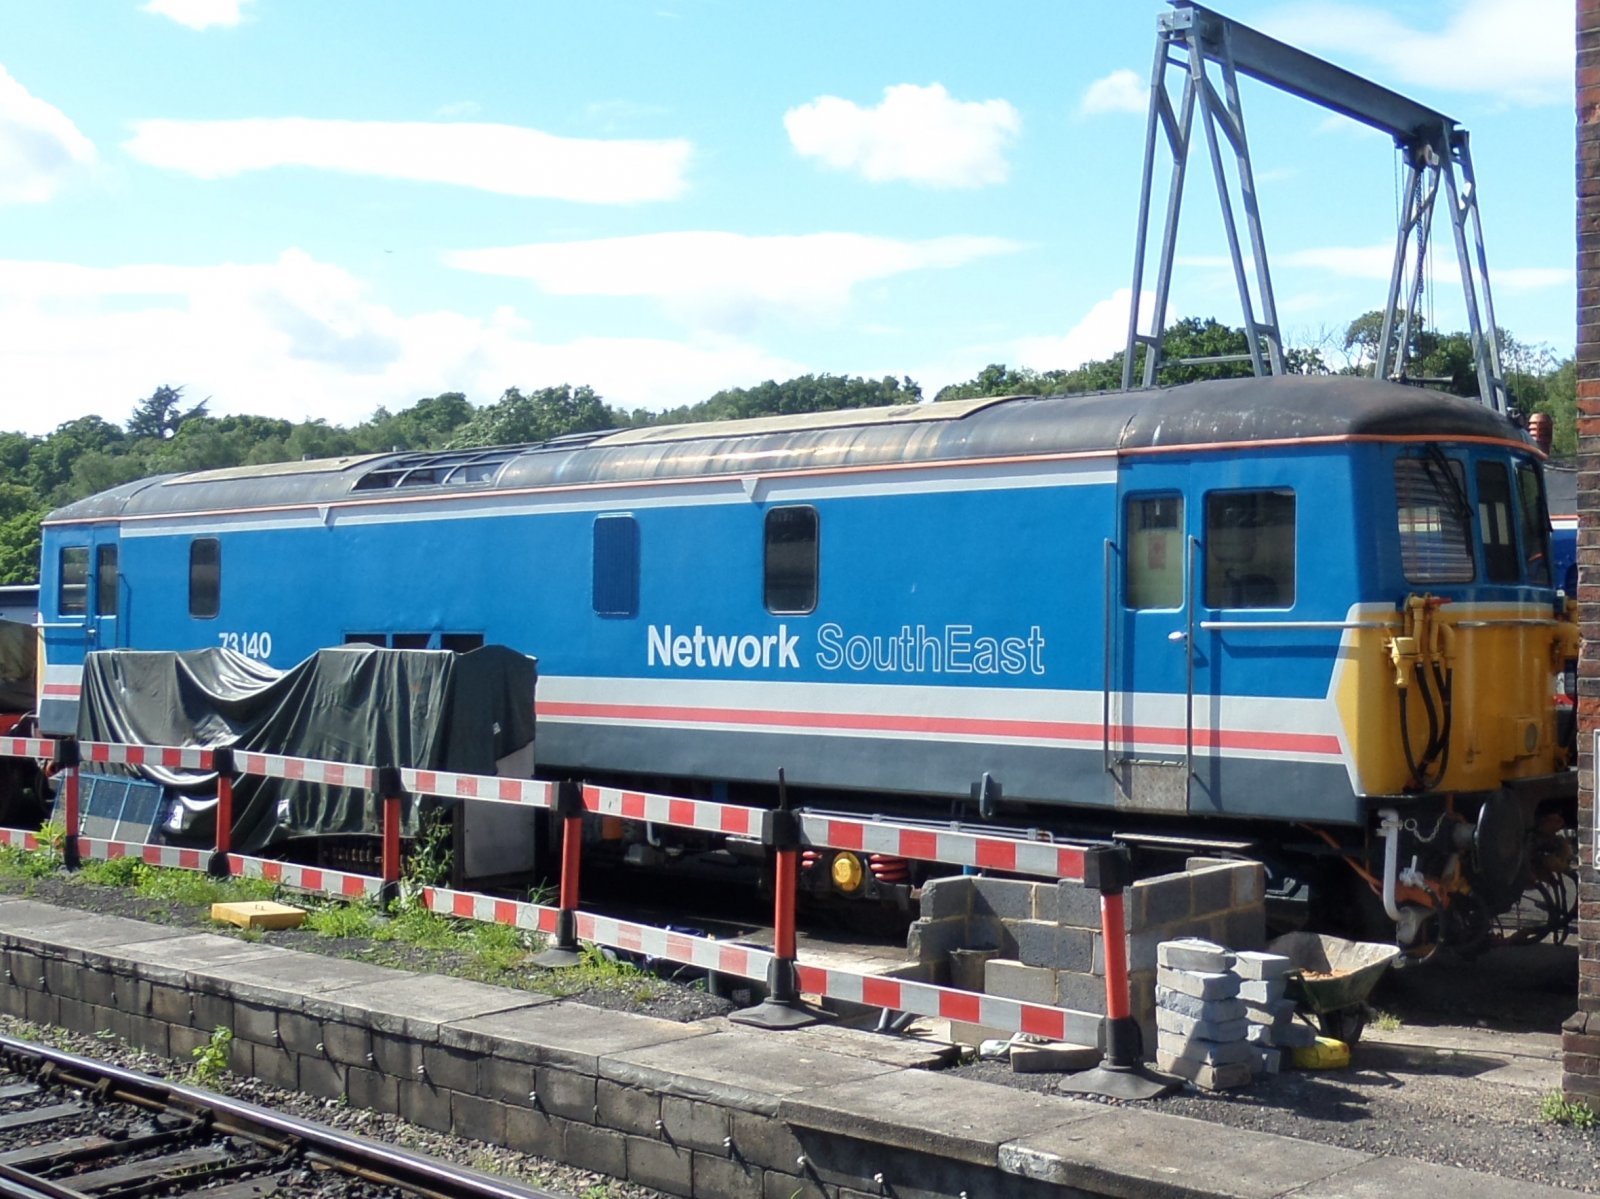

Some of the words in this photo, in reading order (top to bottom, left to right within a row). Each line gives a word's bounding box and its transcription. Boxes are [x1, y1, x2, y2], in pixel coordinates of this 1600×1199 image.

[218, 631, 272, 659] 73140
[647, 624, 800, 668] Network
[816, 623, 1045, 675] SouthEast
